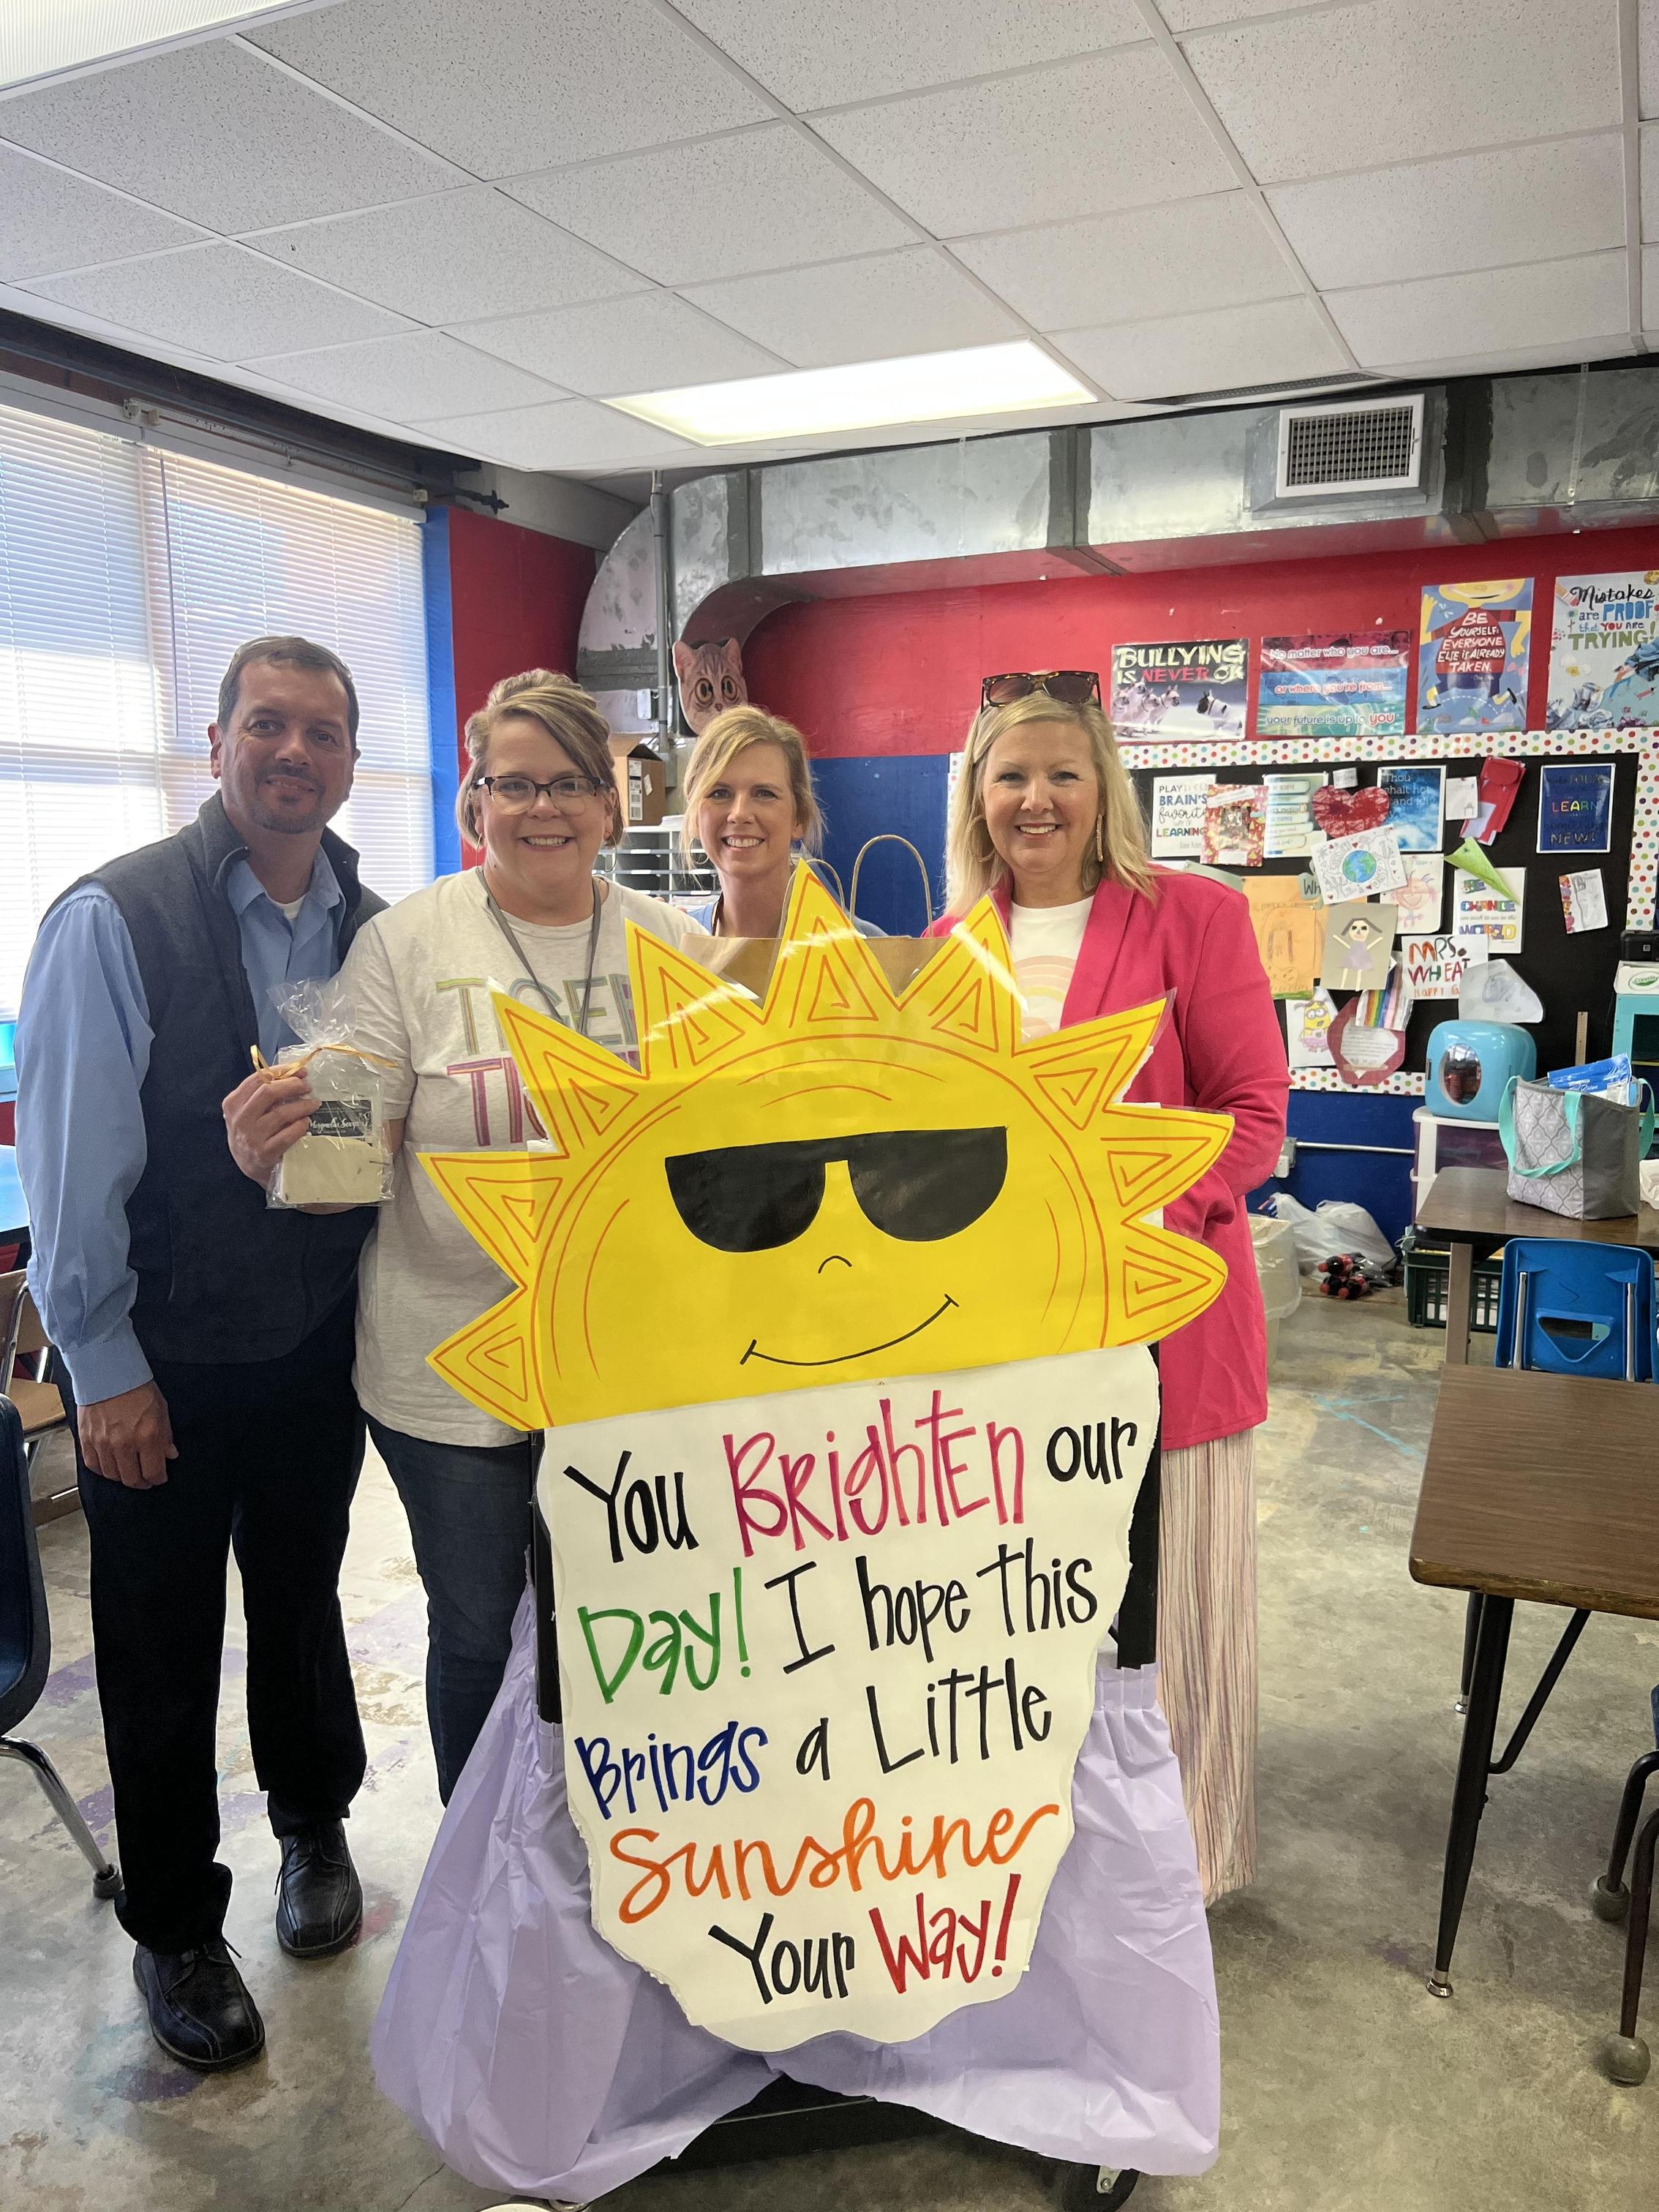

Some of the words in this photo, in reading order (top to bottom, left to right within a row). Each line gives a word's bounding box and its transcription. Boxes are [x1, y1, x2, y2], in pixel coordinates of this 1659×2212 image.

[1570, 584, 1655, 610] Mistakes
[1579, 611, 1600, 621] are
[1602, 600, 1655, 622] PROOF
[1462, 612, 1489, 627] BE
[1579, 622, 1600, 632] that
[1600, 622, 1623, 631] YOU
[1625, 621, 1645, 630] ARE
[1442, 636, 1504, 651] EVERYONE
[1568, 622, 1655, 650] TRYING!
[1116, 644, 1246, 669] BULLYING
[1270, 649, 1286, 659] No
[1287, 647, 1322, 659] matter
[1323, 646, 1345, 658] who
[1347, 647, 1369, 658] you
[1437, 650, 1460, 663] ELSE
[1449, 661, 1492, 673] TAKEN.
[1117, 670, 1137, 685] IS
[1143, 666, 1209, 682] NEVER
[1213, 665, 1245, 682] OK
[1275, 685, 1287, 693] or
[1287, 683, 1321, 693] where
[1266, 716, 1290, 726] your
[1293, 714, 1324, 726] future
[1325, 714, 1336, 723] is
[1338, 715, 1353, 726] up
[1355, 713, 1366, 723] to
[1369, 712, 1395, 726] you
[1385, 773, 1411, 782] Thou
[1159, 785, 1183, 793] PLAY
[1159, 794, 1207, 806] BRAIN'S
[1551, 800, 1597, 812] LEARN
[1551, 832, 1595, 845] NEW!
[1409, 936, 1467, 966] MRS.
[1407, 958, 1470, 987] WHEAT
[563, 1450, 699, 1562] You
[1046, 1415, 1138, 1485] our
[577, 1566, 752, 1704] Day!
[764, 1560, 835, 1674] I
[856, 1555, 971, 1663] hope
[574, 1720, 770, 1821] Brings
[796, 1717, 830, 1781] a
[865, 1658, 1053, 1775] Little
[609, 1797, 1060, 1925] Sunshine
[707, 1912, 855, 2006] Your
[868, 1873, 1022, 1995] Way!
